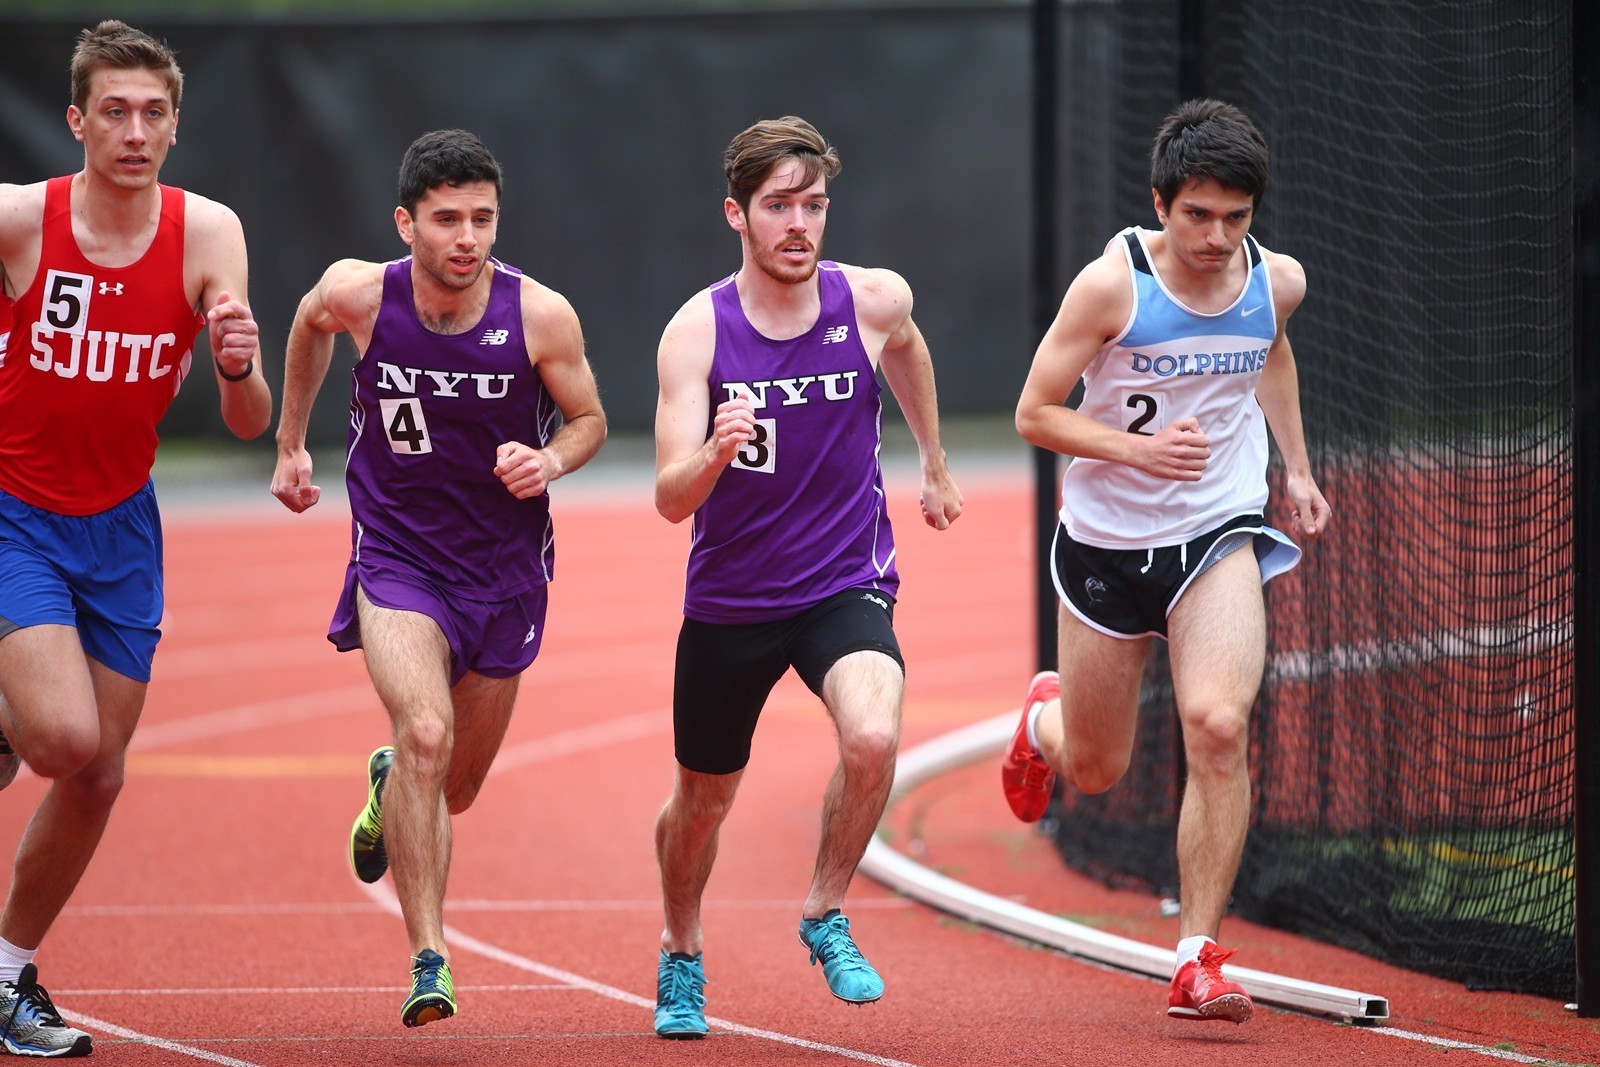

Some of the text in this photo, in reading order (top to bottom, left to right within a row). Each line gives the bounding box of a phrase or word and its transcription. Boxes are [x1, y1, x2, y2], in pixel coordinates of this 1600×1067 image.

[46, 275, 83, 329] 5
[29, 321, 176, 383] SJUTC
[1131, 347, 1268, 377] DOLPHINS
[376, 361, 515, 400] NYU
[722, 371, 859, 410] NYU
[389, 402, 425, 452] 4
[1126, 393, 1158, 437] 2
[737, 423, 769, 468] 3
